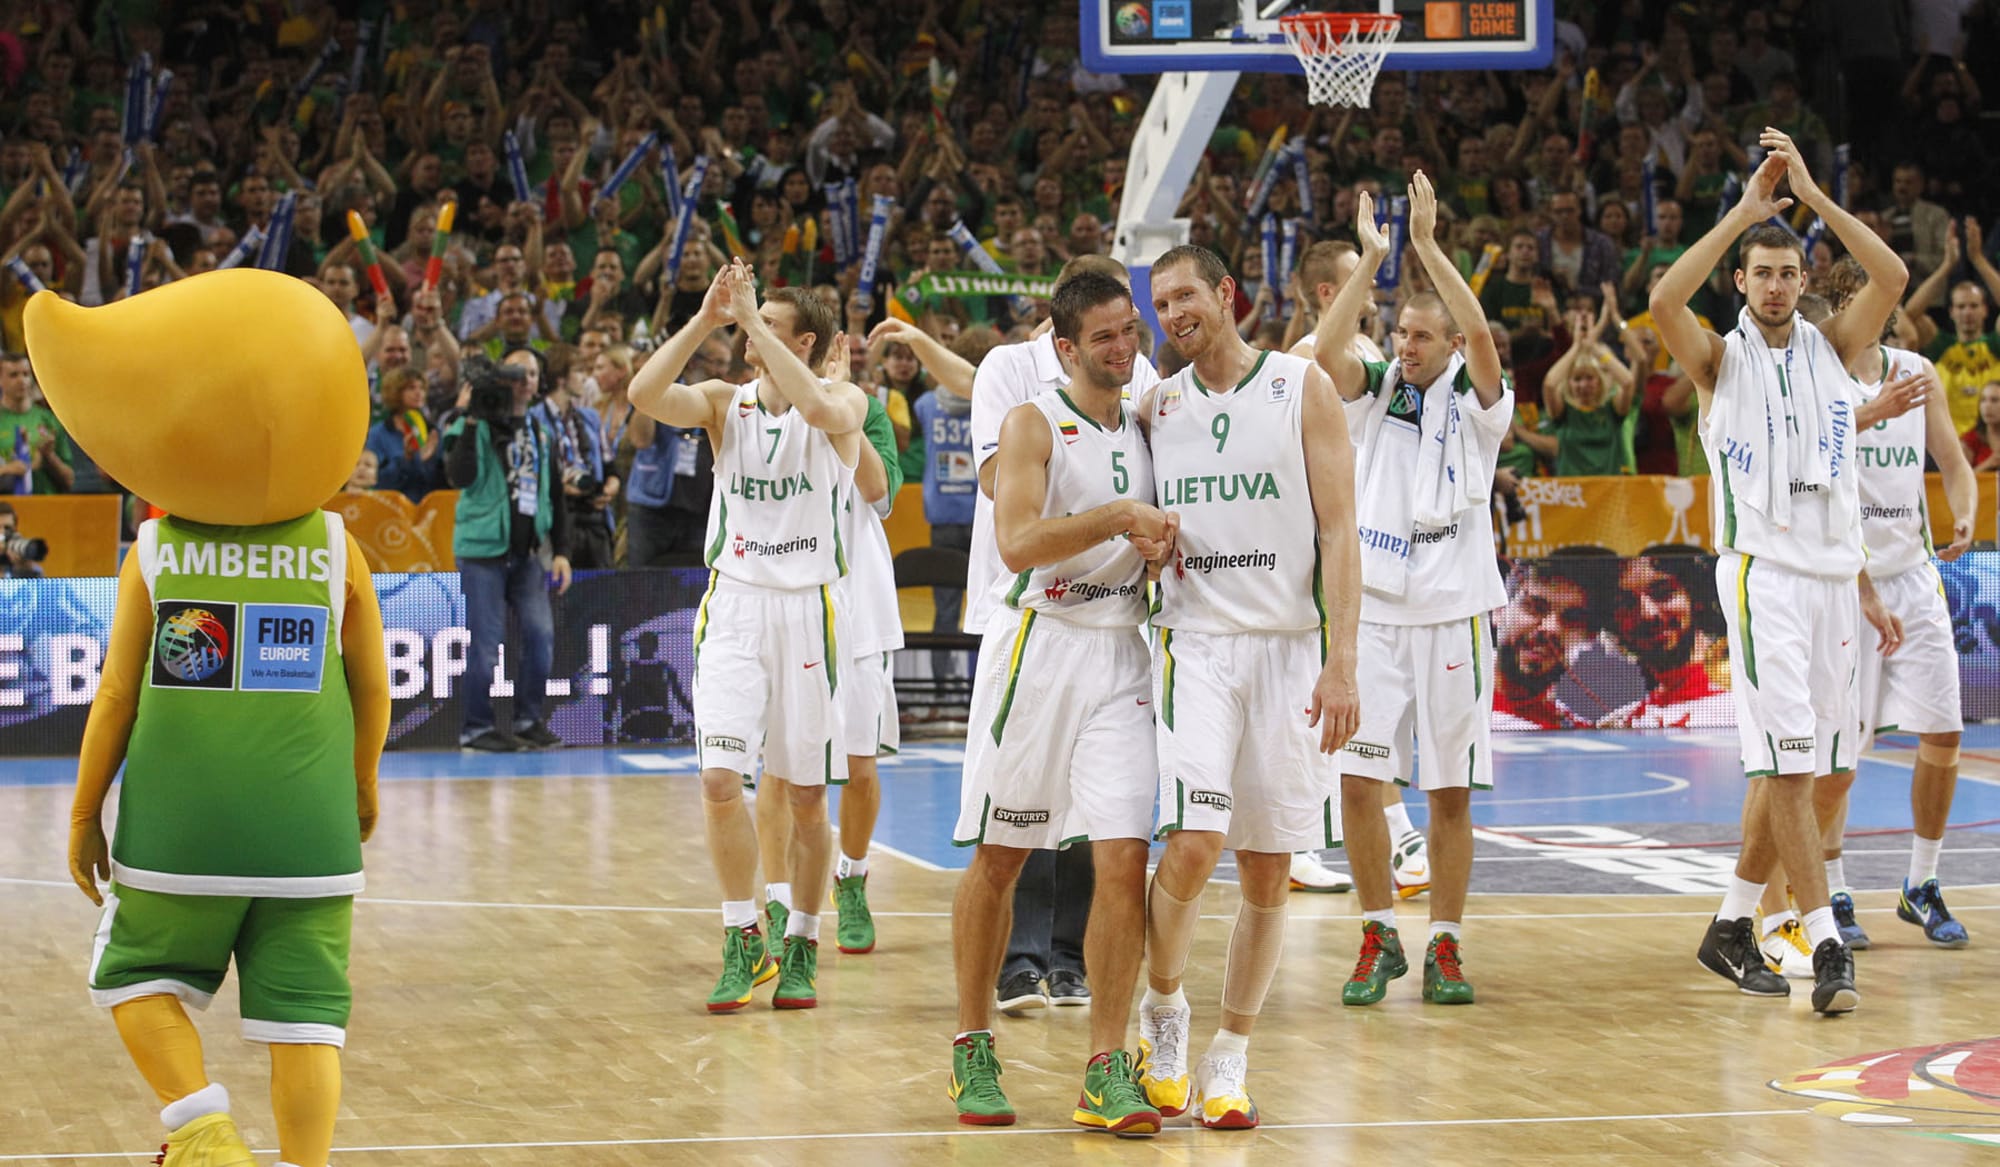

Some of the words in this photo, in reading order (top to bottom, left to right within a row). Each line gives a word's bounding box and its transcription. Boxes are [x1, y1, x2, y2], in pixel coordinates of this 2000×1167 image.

[1469, 3, 1516, 18] CLEAN
[1469, 19, 1516, 35] GAME
[766, 428, 782, 464] 7
[1211, 412, 1231, 454] 9
[730, 471, 813, 501] LIETUVA
[1111, 451, 1129, 494] 5
[1164, 472, 1281, 506] LIETUVA
[745, 536, 817, 557] engineering
[156, 541, 330, 582] AMBERIS
[1185, 549, 1276, 574] engineering
[258, 617, 314, 645] FIBA
[259, 647, 311, 662] EUROPE
[251, 669, 264, 678] We
[266, 669, 280, 678] Are
